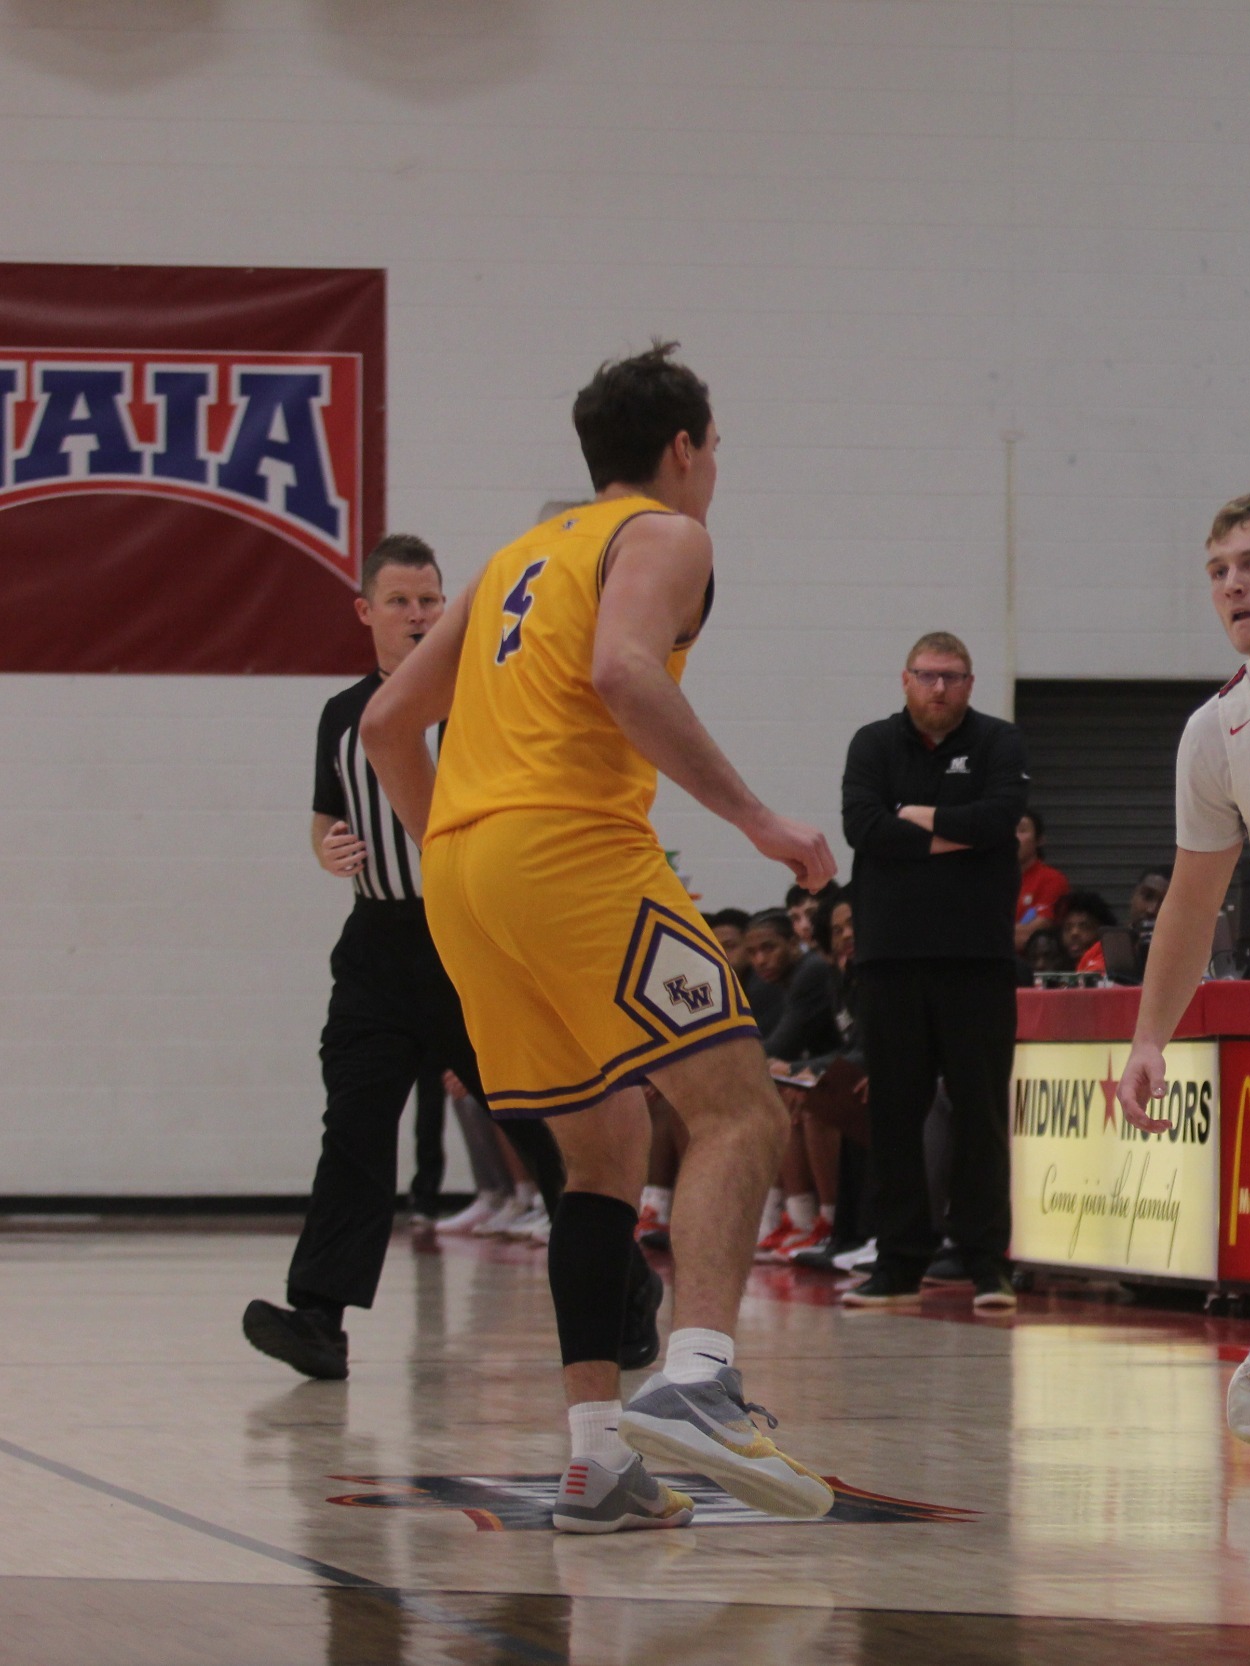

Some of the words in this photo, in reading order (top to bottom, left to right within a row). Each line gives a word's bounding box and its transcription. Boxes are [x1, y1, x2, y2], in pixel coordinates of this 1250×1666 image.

[0, 361, 350, 557] AIA
[1014, 1079, 1096, 1139] MIDWAY
[1041, 1164, 1077, 1215] Come
[1068, 1178, 1107, 1259] join
[1110, 1150, 1132, 1218] the
[1126, 1151, 1181, 1269] family
